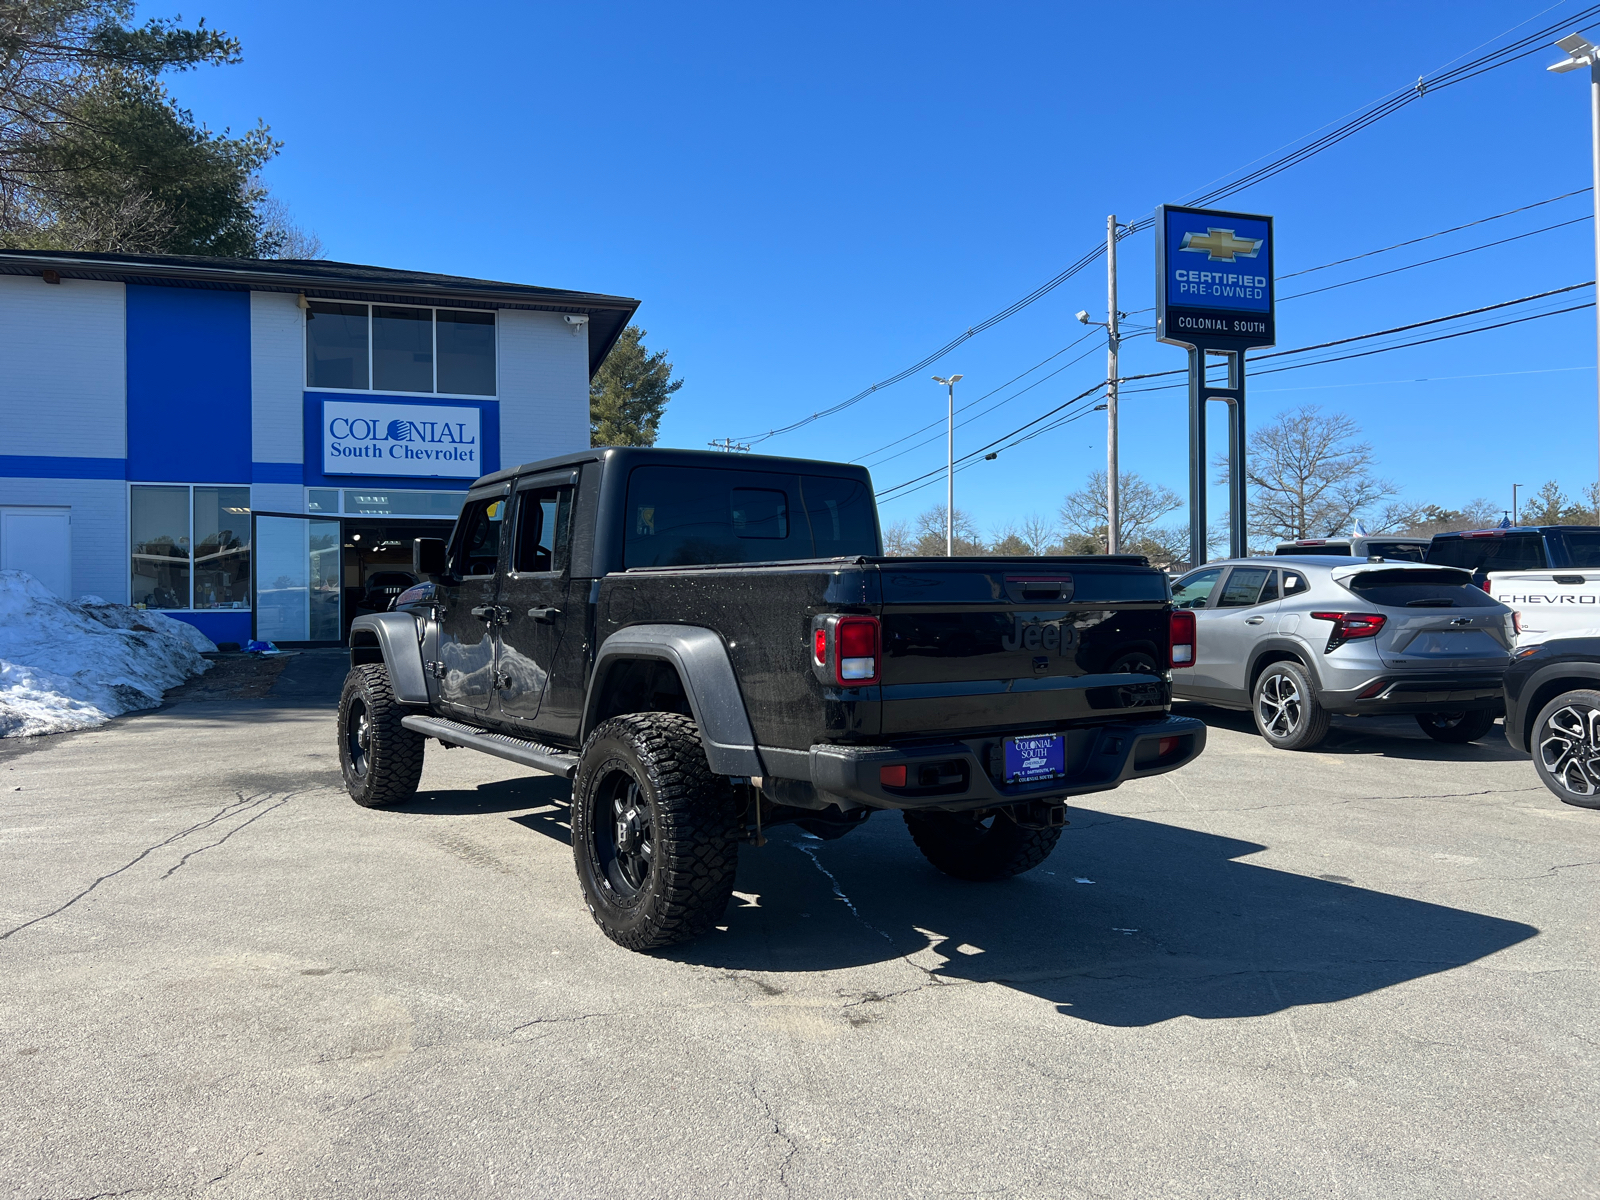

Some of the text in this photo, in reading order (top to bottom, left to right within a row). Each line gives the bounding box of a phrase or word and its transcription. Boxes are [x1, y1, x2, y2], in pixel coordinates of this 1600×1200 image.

[1175, 269, 1266, 288] CERTIFIED
[1180, 283, 1262, 299] PRE-OWNED
[1178, 317, 1265, 333] COLONIAL SOUTH
[329, 417, 475, 445] COLONIAL
[330, 442, 475, 461] South Chevrolet
[1498, 595, 1600, 604] CHEVRO
[1001, 616, 1078, 657] Jeep
[1015, 739, 1053, 751] COLONIAL
[1021, 748, 1046, 758] SOUTH
